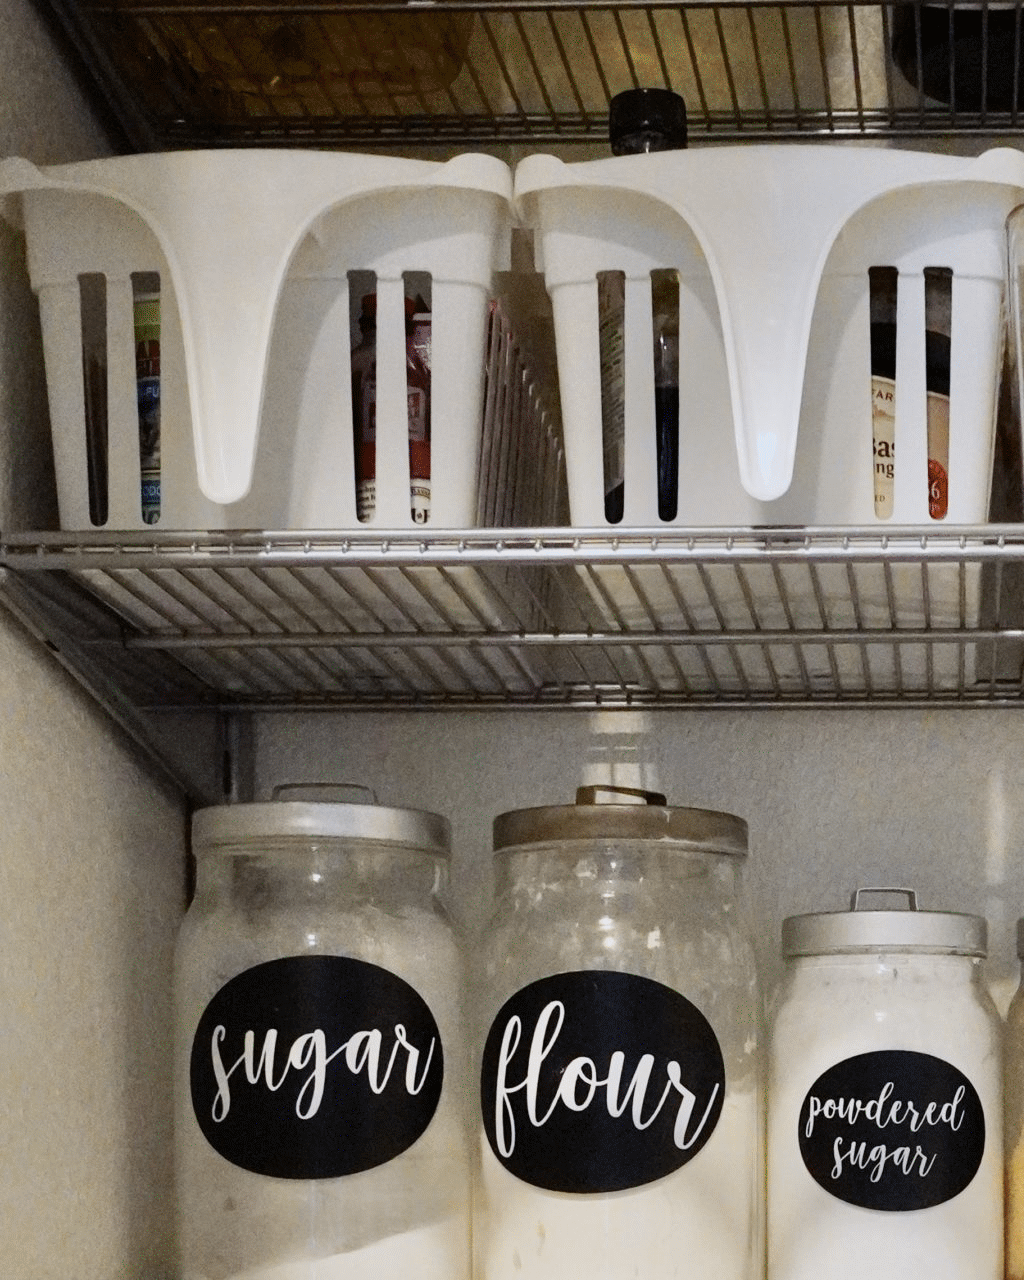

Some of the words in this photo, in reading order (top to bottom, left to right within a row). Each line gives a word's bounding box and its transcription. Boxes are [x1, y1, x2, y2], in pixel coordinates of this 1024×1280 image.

[211, 1023, 436, 1123] sugar
[496, 1000, 720, 1158] flour
[805, 1081, 966, 1138] powdered
[830, 1135, 937, 1183] sugar
